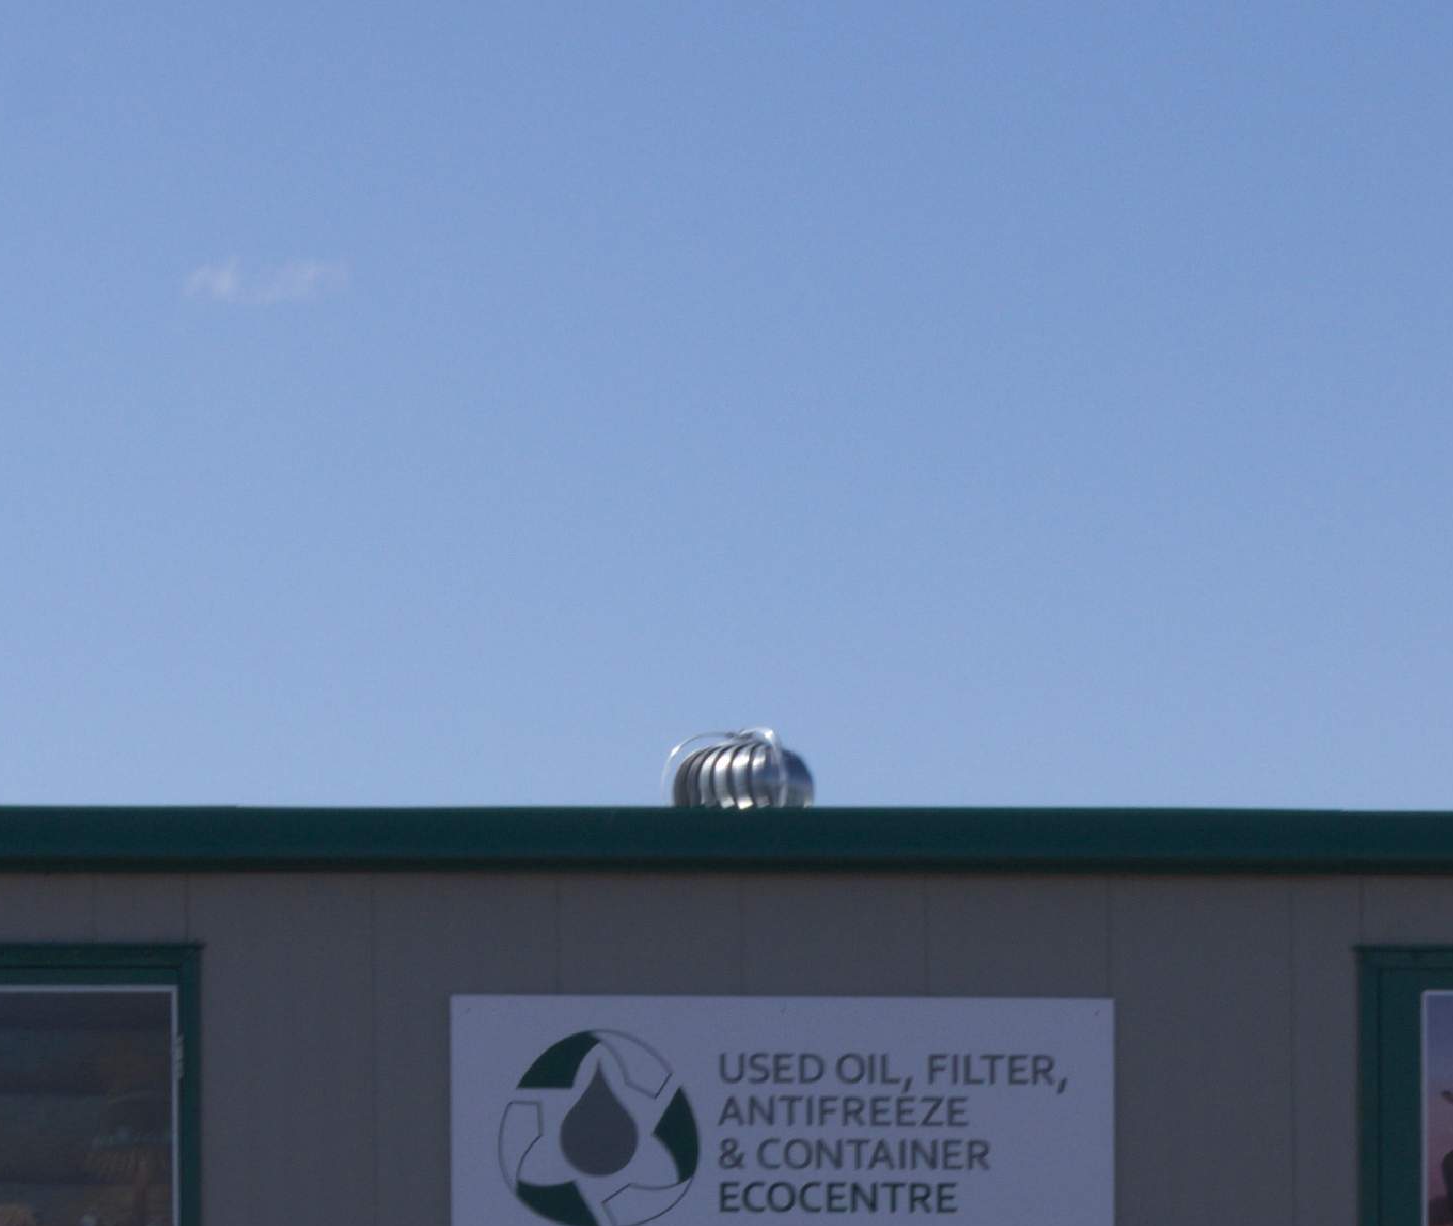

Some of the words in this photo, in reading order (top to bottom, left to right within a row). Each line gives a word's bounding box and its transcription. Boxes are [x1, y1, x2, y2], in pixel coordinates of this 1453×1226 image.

[720, 1053, 824, 1084] USED
[836, 1053, 912, 1093] OIL,
[928, 1054, 1067, 1094] FILTER,
[719, 1096, 968, 1127] ANTIFREEZE
[719, 1139, 744, 1169] &
[757, 1138, 989, 1170] CONTAINER
[720, 1182, 956, 1213] ECOCENTRE
